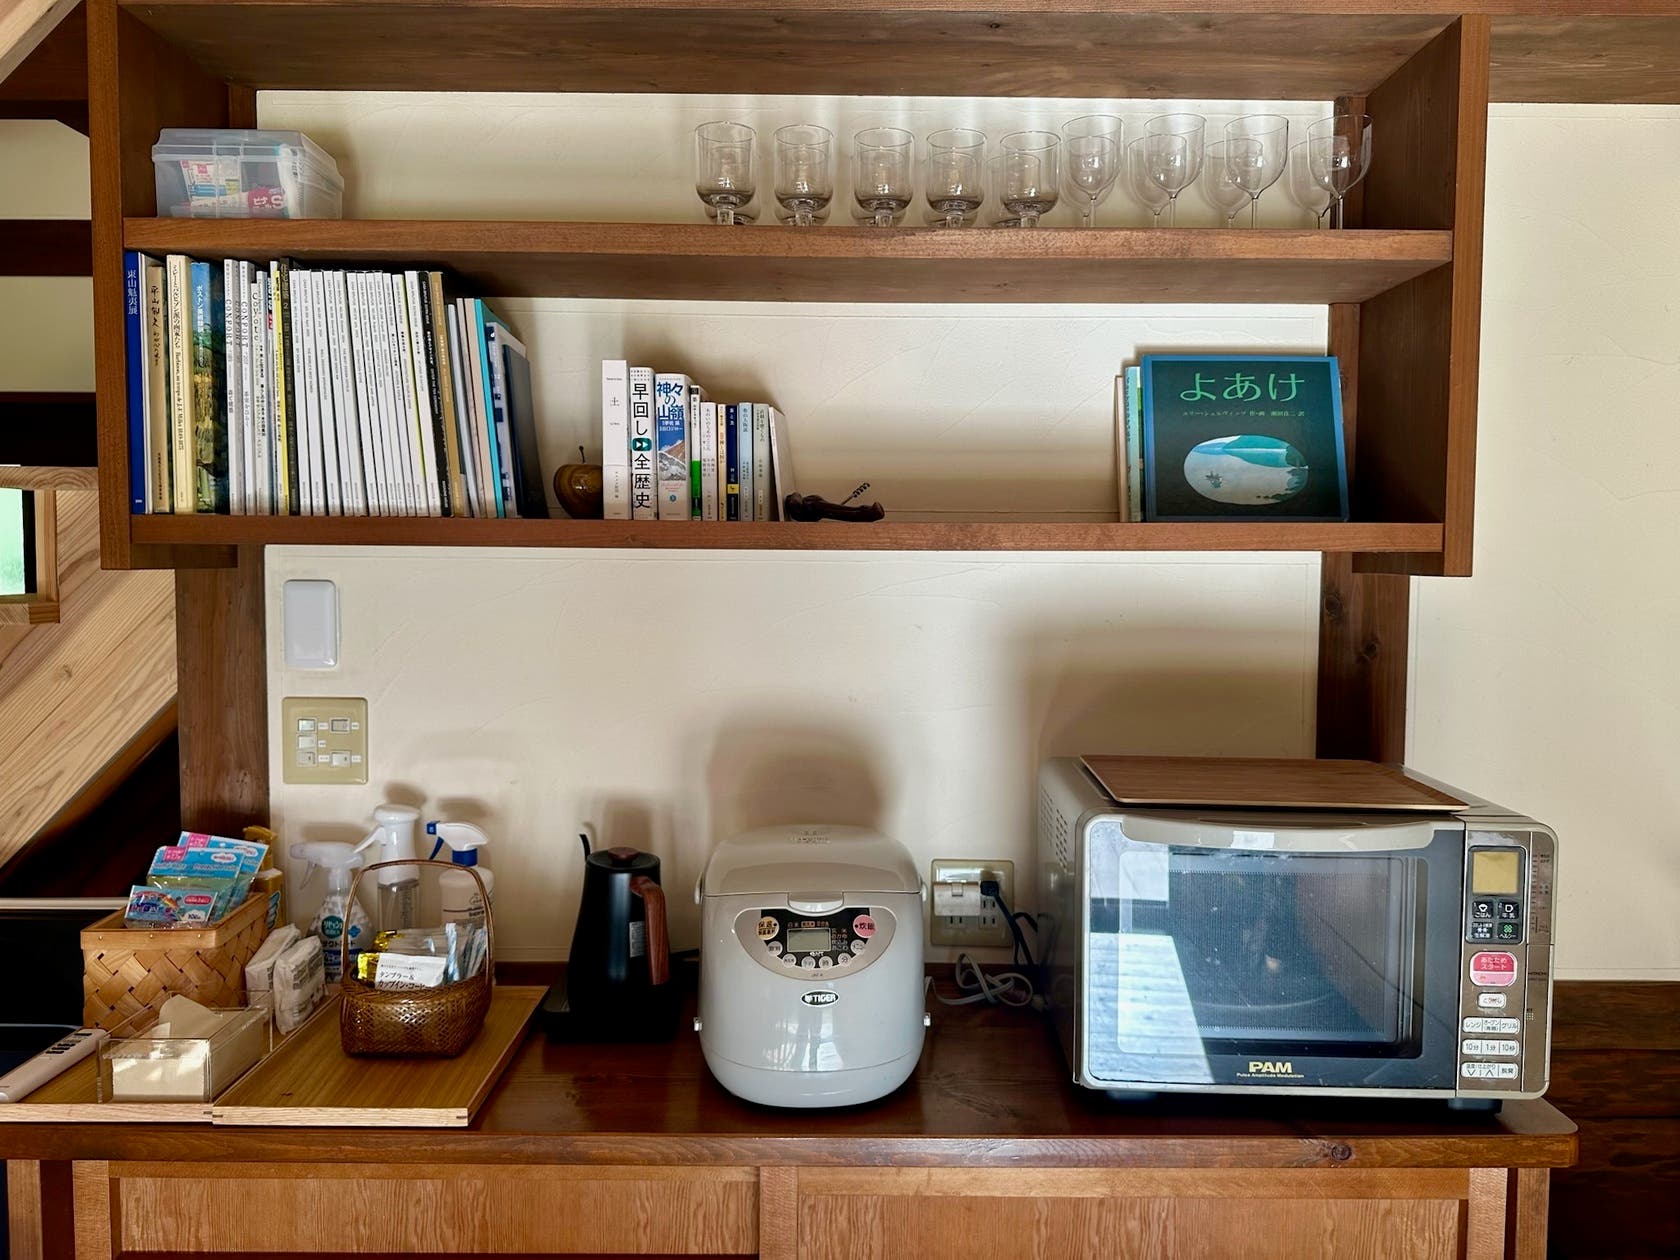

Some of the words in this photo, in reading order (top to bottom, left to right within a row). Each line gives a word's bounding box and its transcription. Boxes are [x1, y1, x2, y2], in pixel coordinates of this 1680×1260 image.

[127, 270, 138, 315] 東山魁夷展
[657, 382, 683, 397] 神々
[1180, 373, 1305, 402] よあけ
[632, 383, 649, 435] 早回し
[658, 405, 684, 420] 山嶺
[634, 454, 650, 508] 全歴史
[813, 994, 836, 1002] TIGER
[1249, 1062, 1292, 1073] PAM
